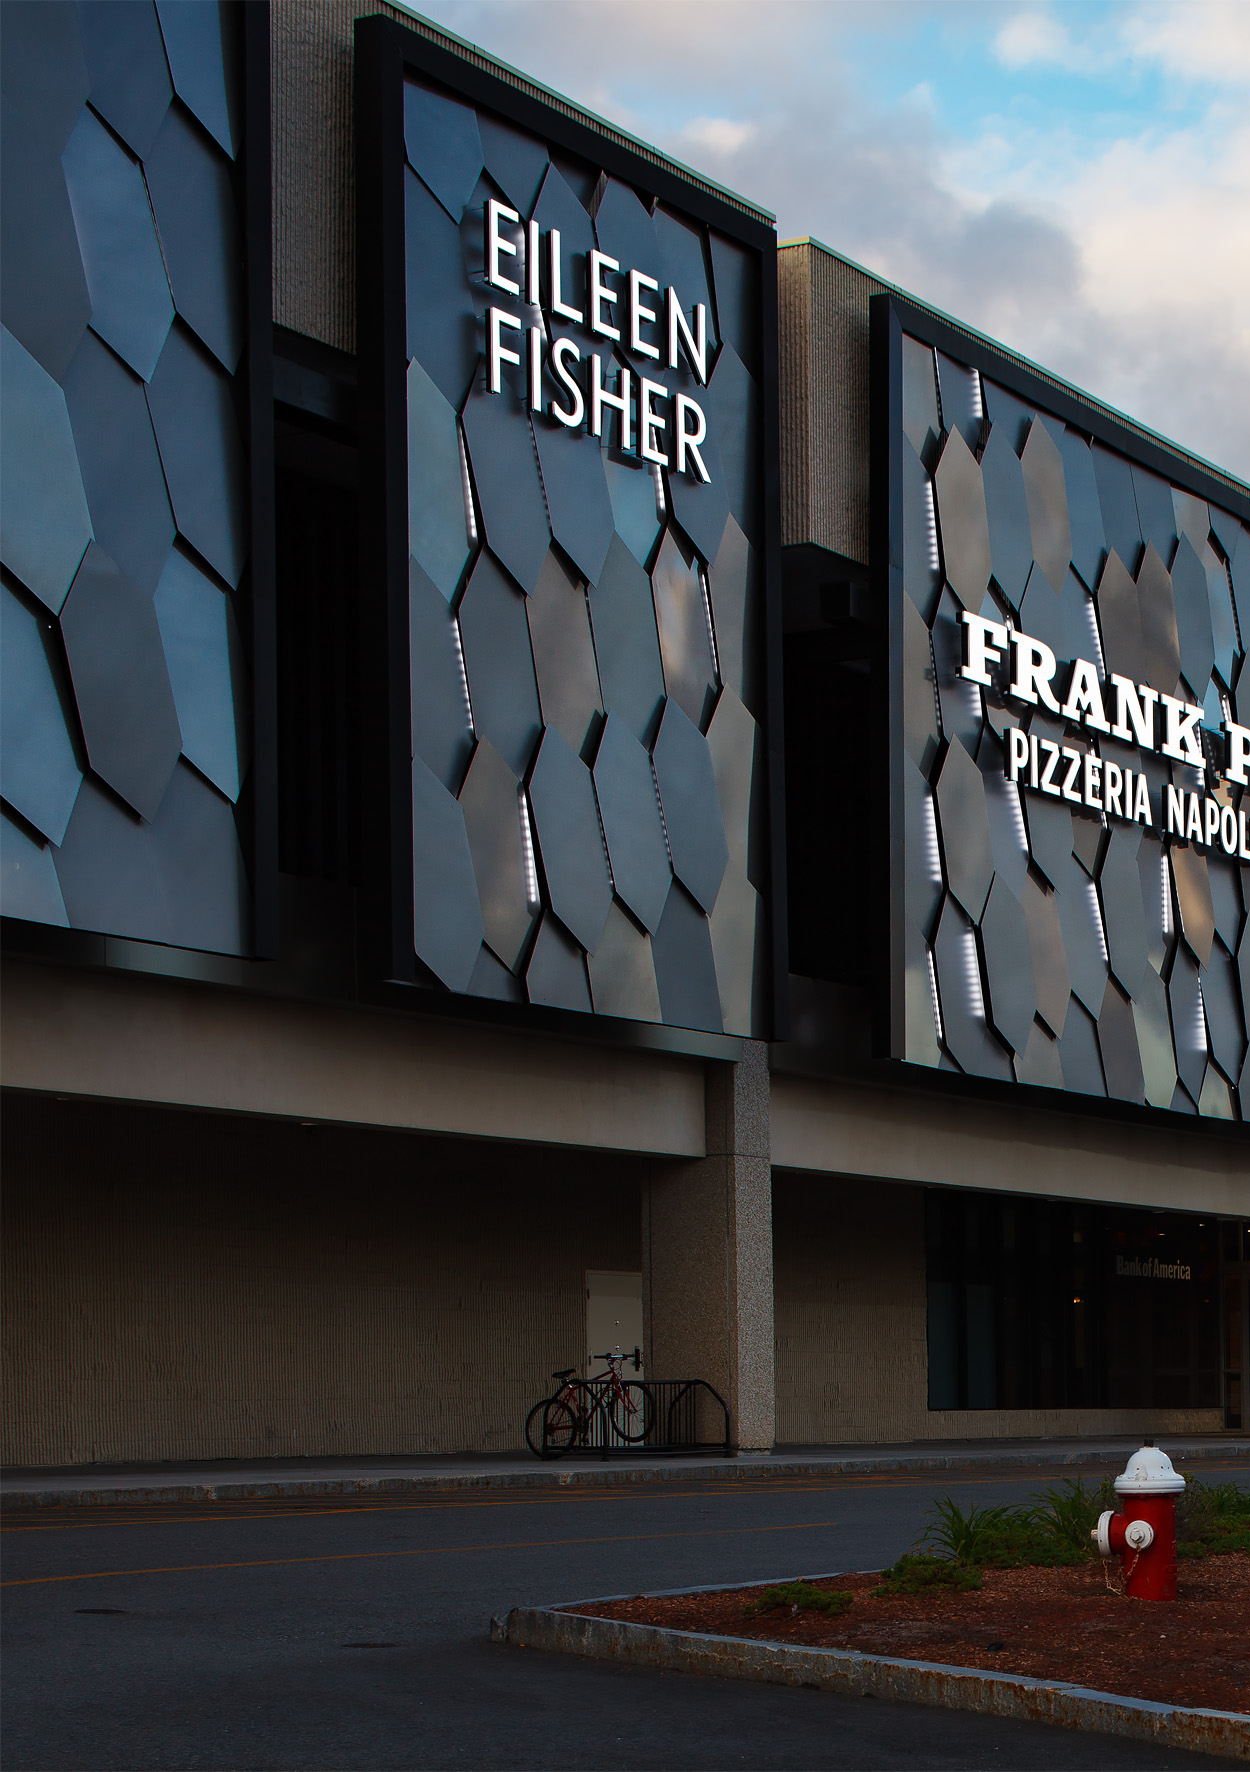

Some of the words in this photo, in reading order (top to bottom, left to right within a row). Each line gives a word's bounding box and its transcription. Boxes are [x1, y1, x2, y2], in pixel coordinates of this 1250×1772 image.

[487, 198, 706, 387] EILEEN
[488, 306, 711, 484] FISHER
[959, 610, 1207, 769] FRANK
[1008, 727, 1153, 827] PIZZERIA
[1115, 1254, 1142, 1277] Bank
[1142, 1257, 1153, 1278] of
[1153, 1257, 1191, 1280] America
